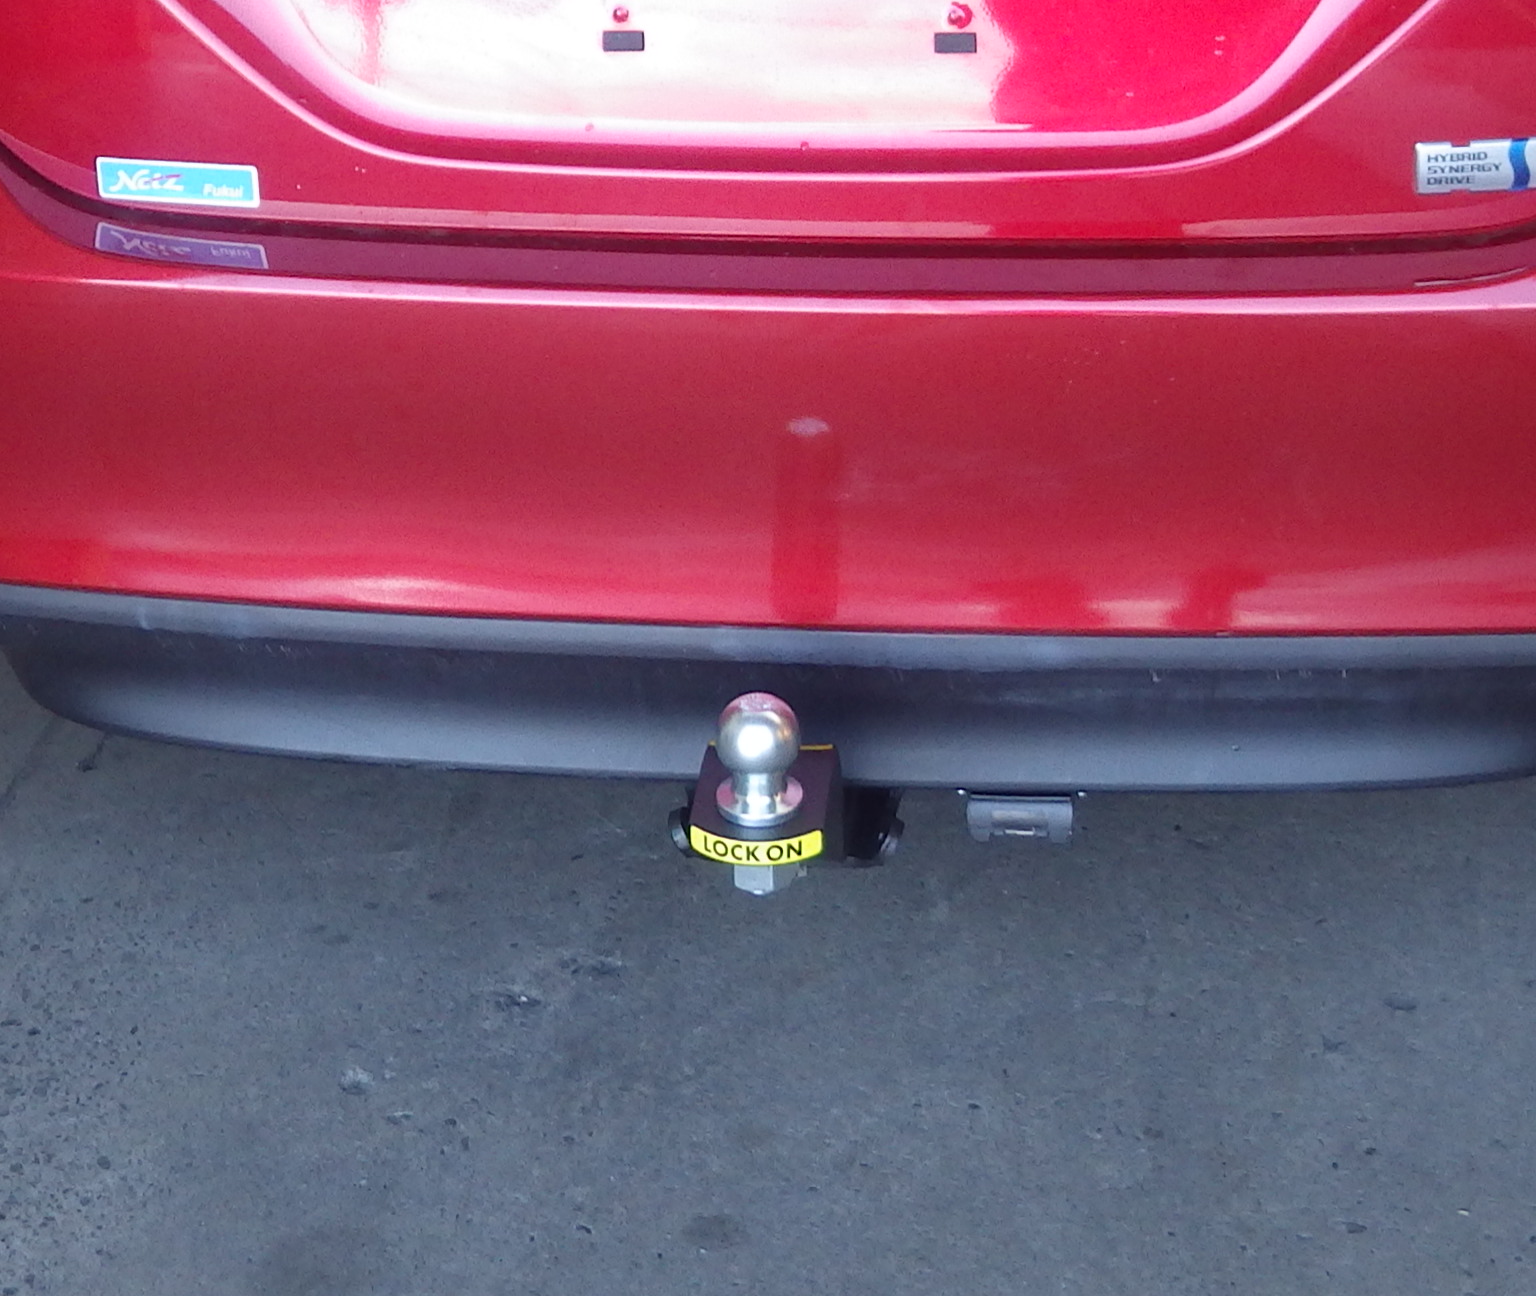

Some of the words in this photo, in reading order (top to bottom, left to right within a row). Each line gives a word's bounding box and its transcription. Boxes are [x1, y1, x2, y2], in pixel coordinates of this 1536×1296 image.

[1427, 151, 1488, 163] HYBRID
[1427, 163, 1502, 175] SYNERGY
[1427, 175, 1475, 185] DRIVE
[204, 183, 244, 198] Fukui
[704, 835, 761, 862] LOCK
[766, 840, 802, 861] ON
